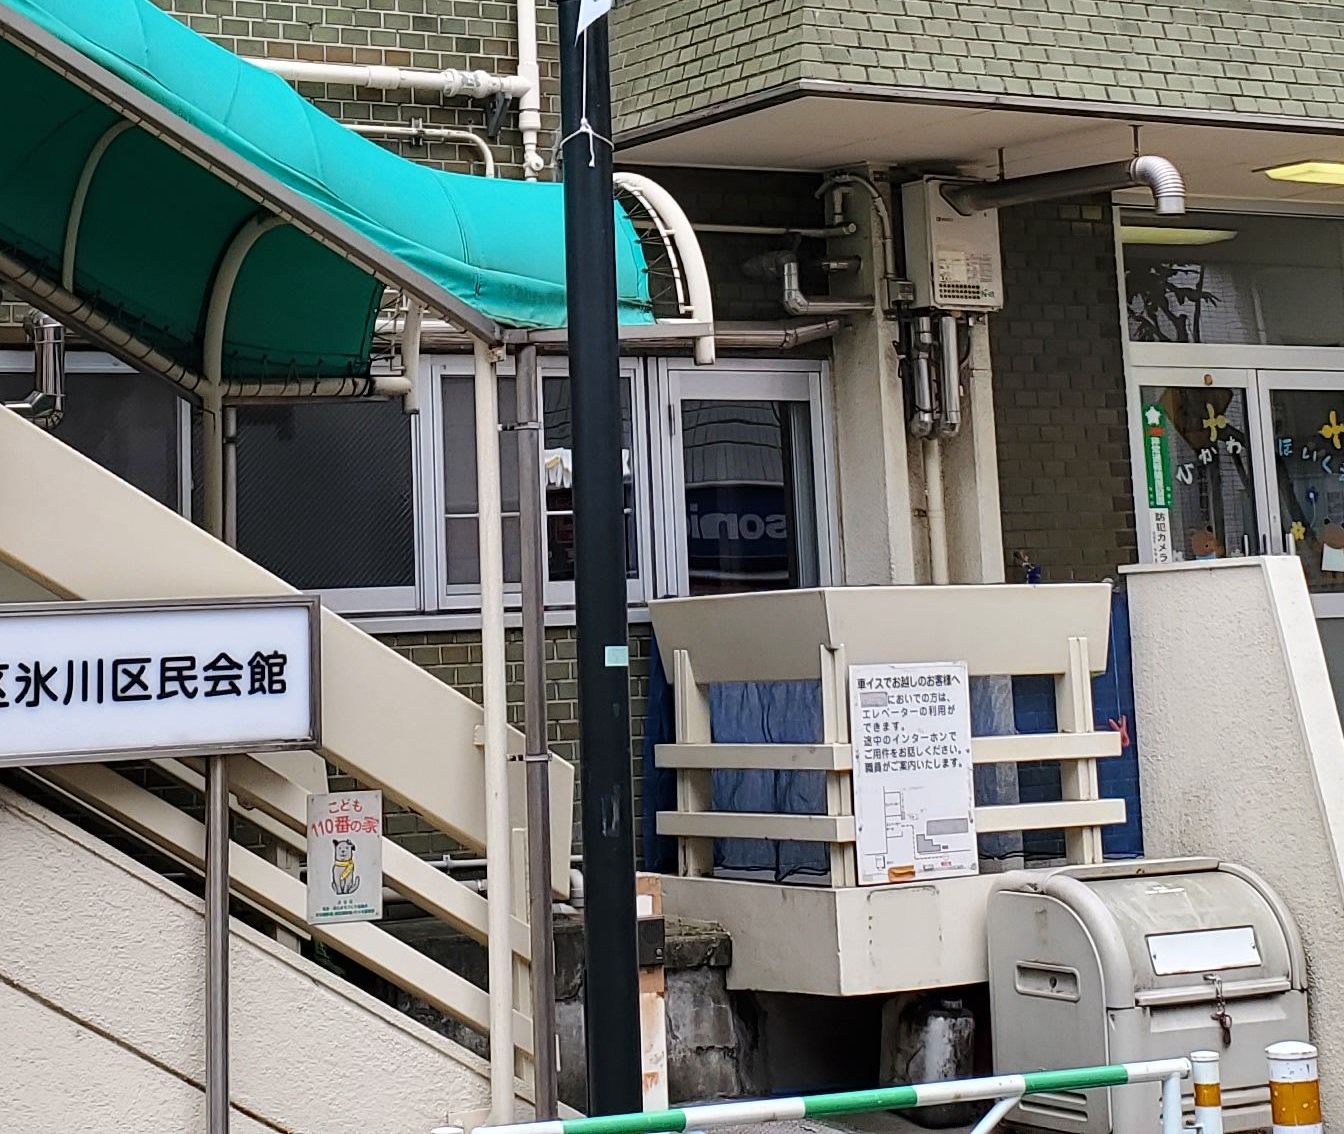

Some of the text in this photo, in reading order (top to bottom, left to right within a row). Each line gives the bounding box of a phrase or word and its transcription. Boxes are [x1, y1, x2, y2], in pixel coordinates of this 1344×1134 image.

[1176, 435, 1242, 485] ひかわ
[1154, 512, 1168, 563] 防犯カメラ
[857, 674, 961, 689] 車イスでお越しのお客様へ
[862, 704, 956, 719] エレベーターの利用が
[863, 721, 905, 732] できます。
[863, 731, 957, 746] 途中のインターホンで
[864, 745, 962, 760] ご用件をお話しください。
[864, 758, 963, 773] 職員がご案内いたします。
[328, 798, 363, 814] こども
[311, 815, 380, 837] 110番の家
